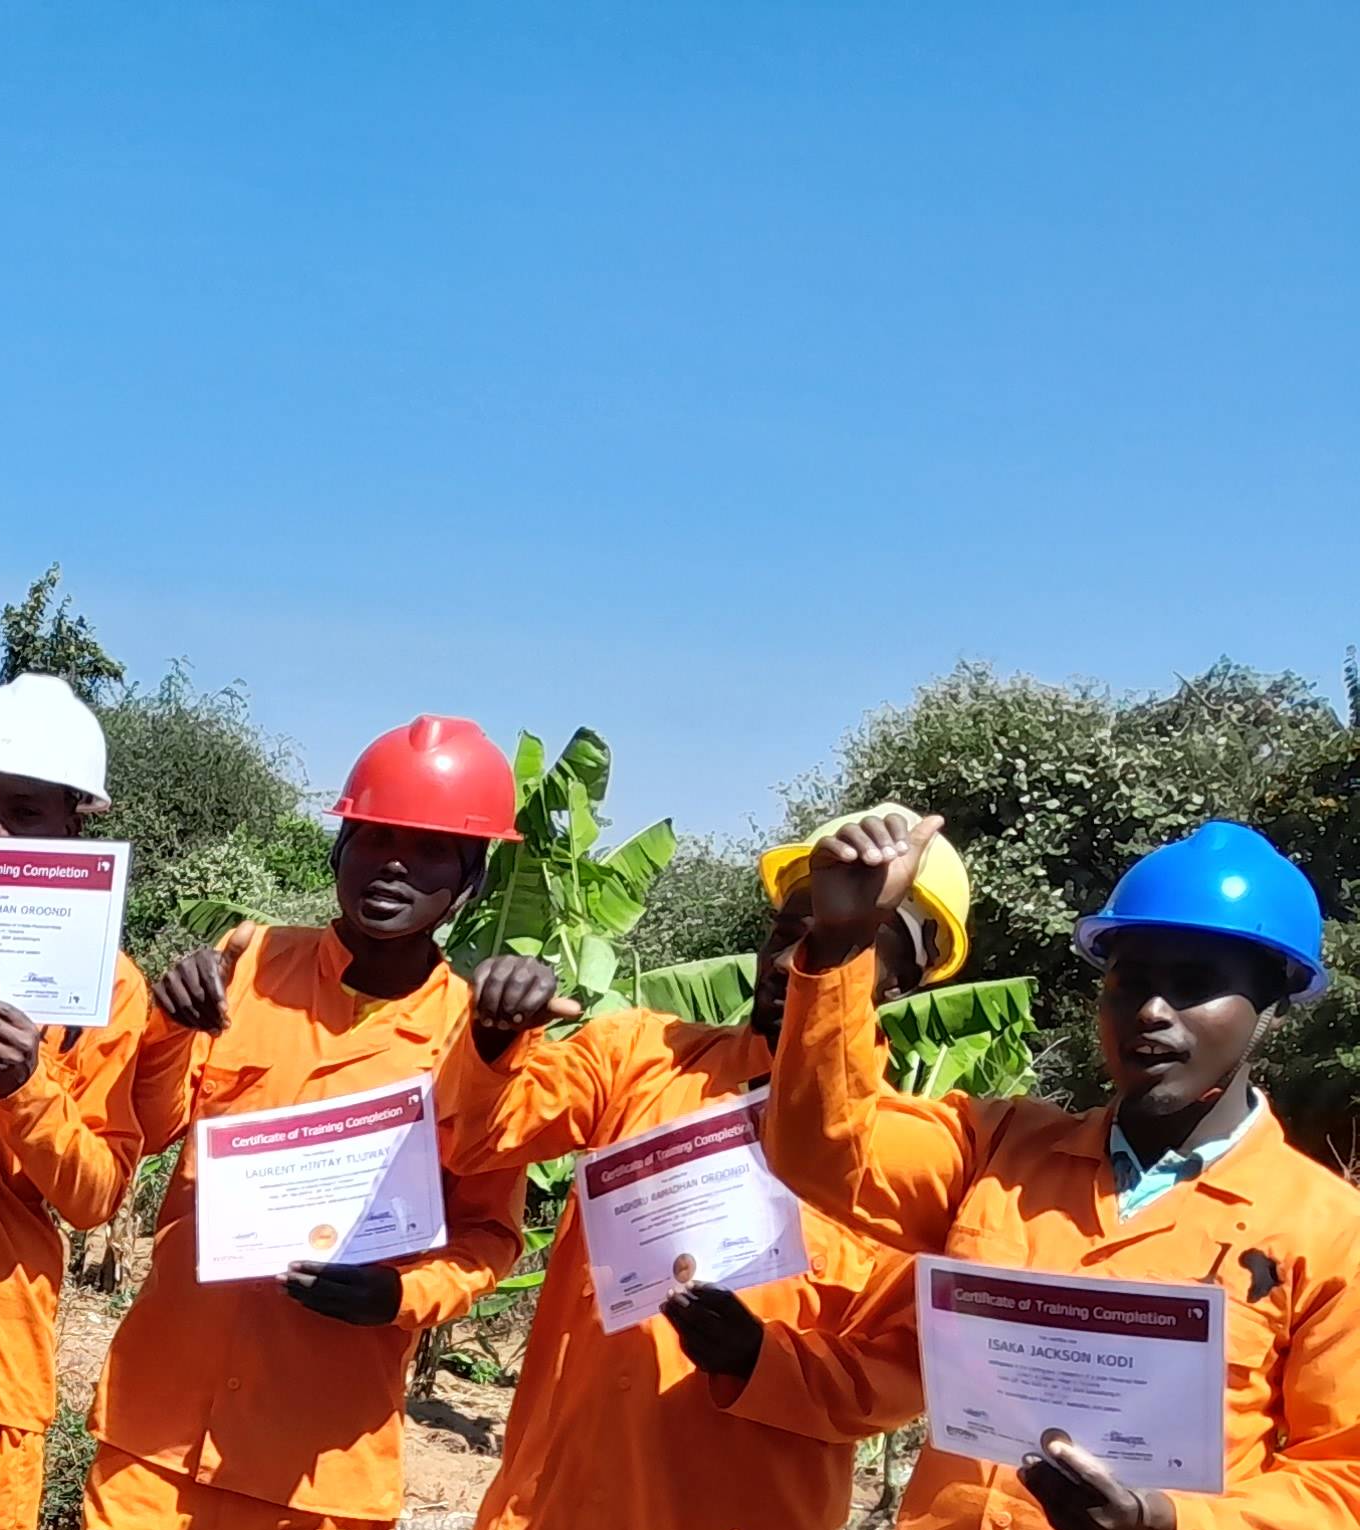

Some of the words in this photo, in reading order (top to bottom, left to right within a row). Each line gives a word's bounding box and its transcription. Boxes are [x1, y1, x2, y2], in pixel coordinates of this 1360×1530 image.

[23, 864, 88, 878] Completion
[988, 1338, 1024, 1353] ISAKA
[1031, 1345, 1091, 1363] JACKSON
[1097, 1354, 1133, 1368] KODI
